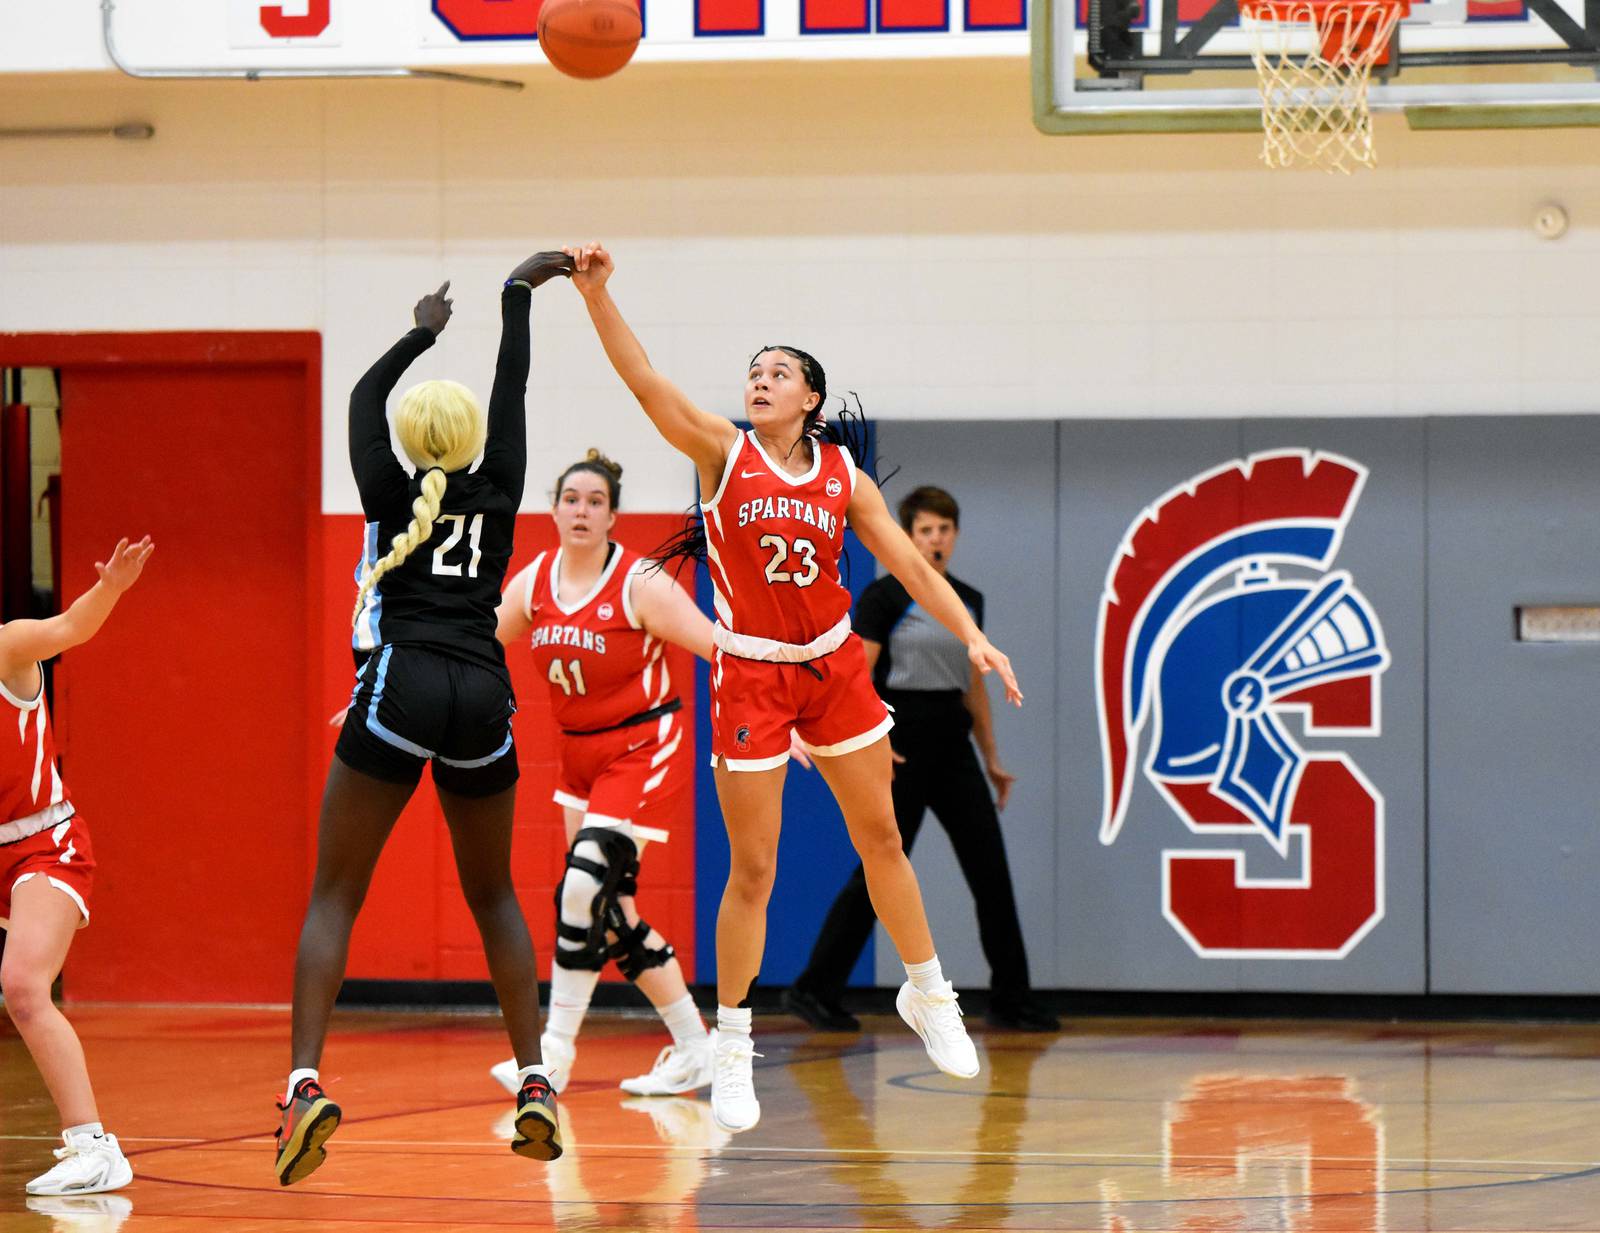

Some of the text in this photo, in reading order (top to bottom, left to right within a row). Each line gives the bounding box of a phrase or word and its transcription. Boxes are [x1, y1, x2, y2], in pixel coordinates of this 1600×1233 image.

[738, 496, 837, 540] SPARTANS
[432, 513, 484, 578] 21
[759, 533, 820, 588] 23
[531, 624, 606, 654] SPARTANS
[548, 658, 586, 696] 41
